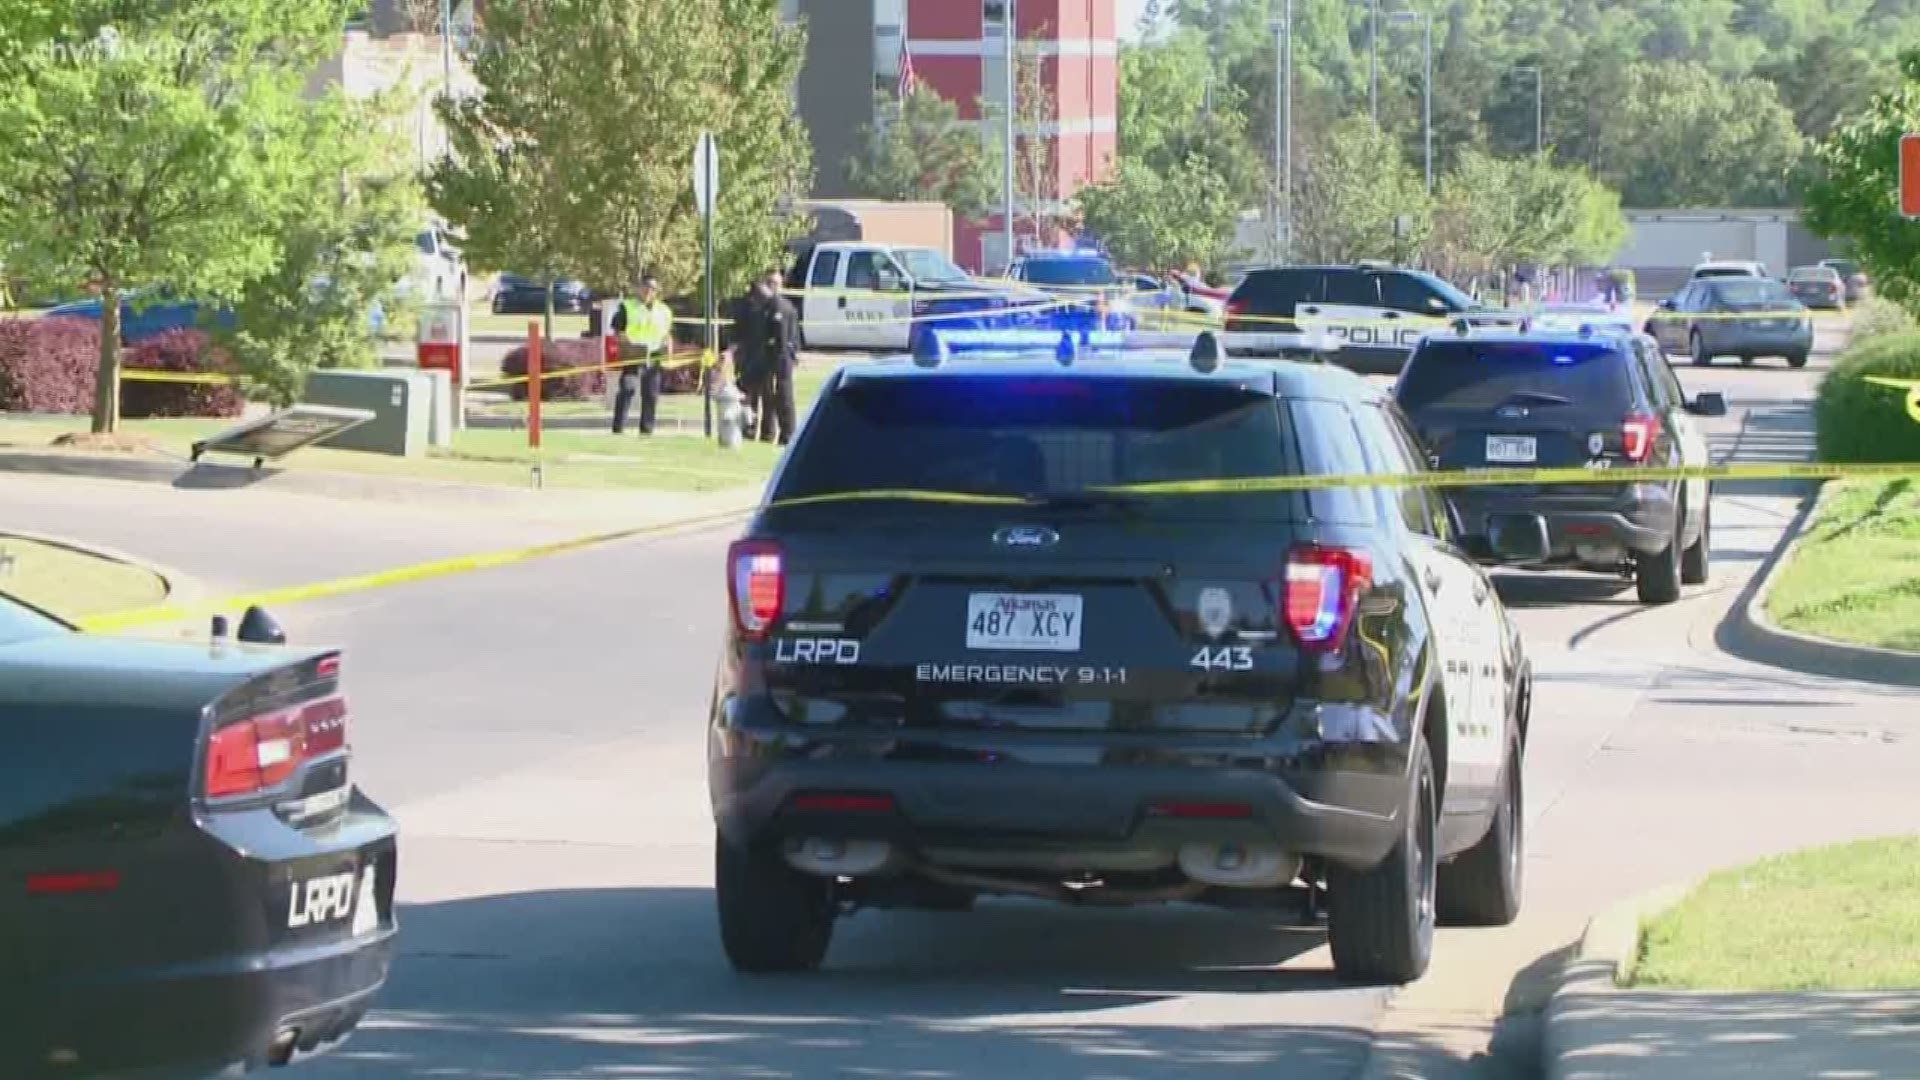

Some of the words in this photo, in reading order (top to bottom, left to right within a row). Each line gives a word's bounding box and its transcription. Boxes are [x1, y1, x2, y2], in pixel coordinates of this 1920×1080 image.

[1326, 326, 1413, 345] POLIC
[972, 611, 1016, 637] 487
[1027, 611, 1075, 637] XCY
[775, 638, 860, 664] LRPD
[1189, 646, 1254, 671] 443
[916, 664, 1069, 683] EMERGENCY
[1078, 666, 1127, 684] 9-1-1
[287, 873, 355, 929] LRPD
